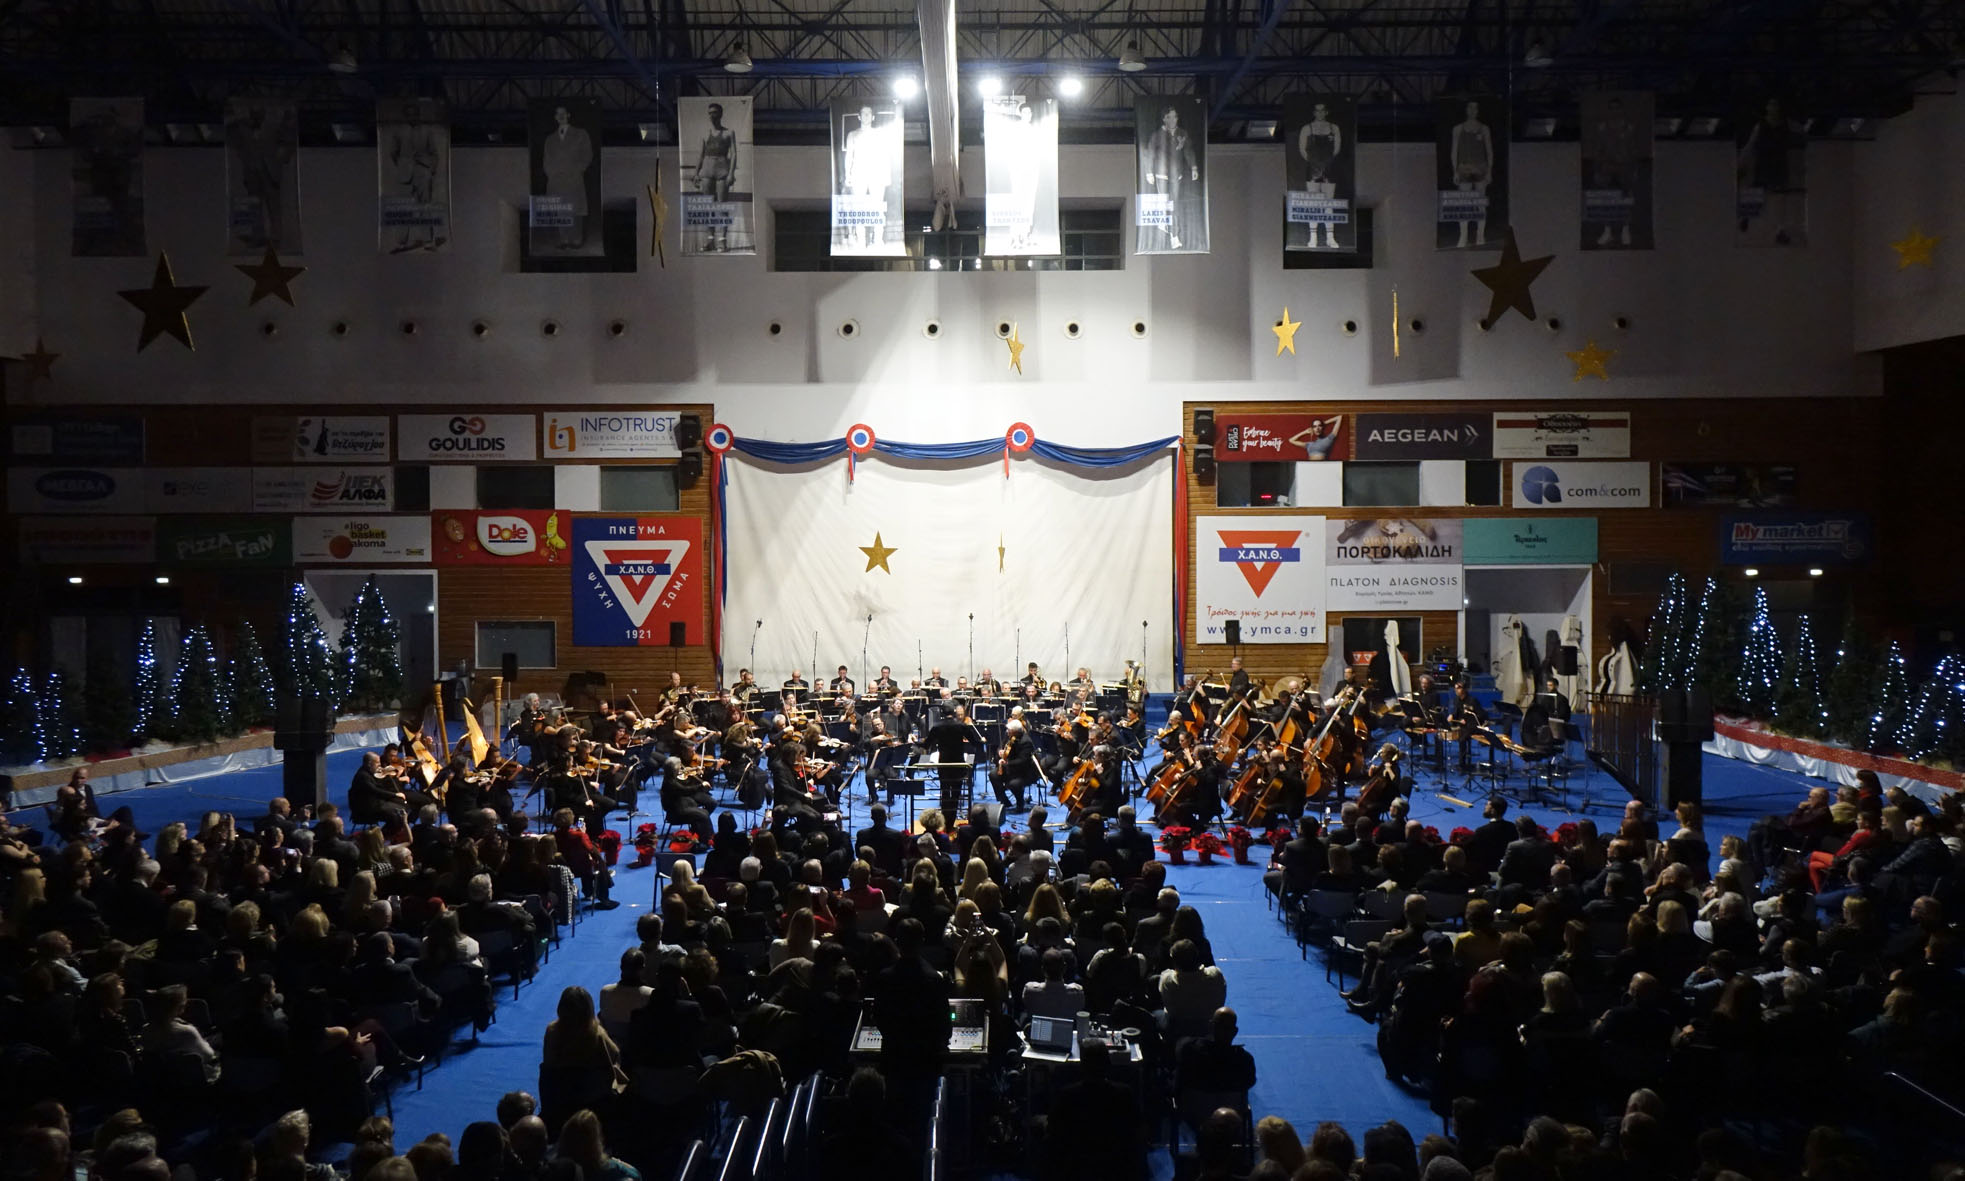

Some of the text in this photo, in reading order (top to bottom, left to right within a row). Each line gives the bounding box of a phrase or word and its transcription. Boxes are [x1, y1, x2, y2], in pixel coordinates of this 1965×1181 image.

[580, 417, 676, 433] INFOTRUST
[1367, 429, 1459, 442] AEGEAN
[428, 437, 506, 452] GOULIDIS
[1567, 482, 1641, 497] com&com
[350, 529, 387, 539] basket
[488, 523, 529, 541] Dole
[609, 525, 666, 535] ΠΝΕΥΜΑ
[1733, 523, 1824, 541] My market
[1238, 550, 1283, 560] Χ.Α.Ν.Θ.
[1337, 546, 1453, 559] ΠΟΡΤΟΚΑΛΙΔΗ
[619, 565, 658, 574] Χ.Α.Ν.Θ.
[587, 572, 615, 609] ΨΥΧΗ
[662, 572, 689, 609] ΣΩΜΑ
[626, 629, 652, 639] 1921
[1207, 625, 1317, 637] ww.ymca.gr
